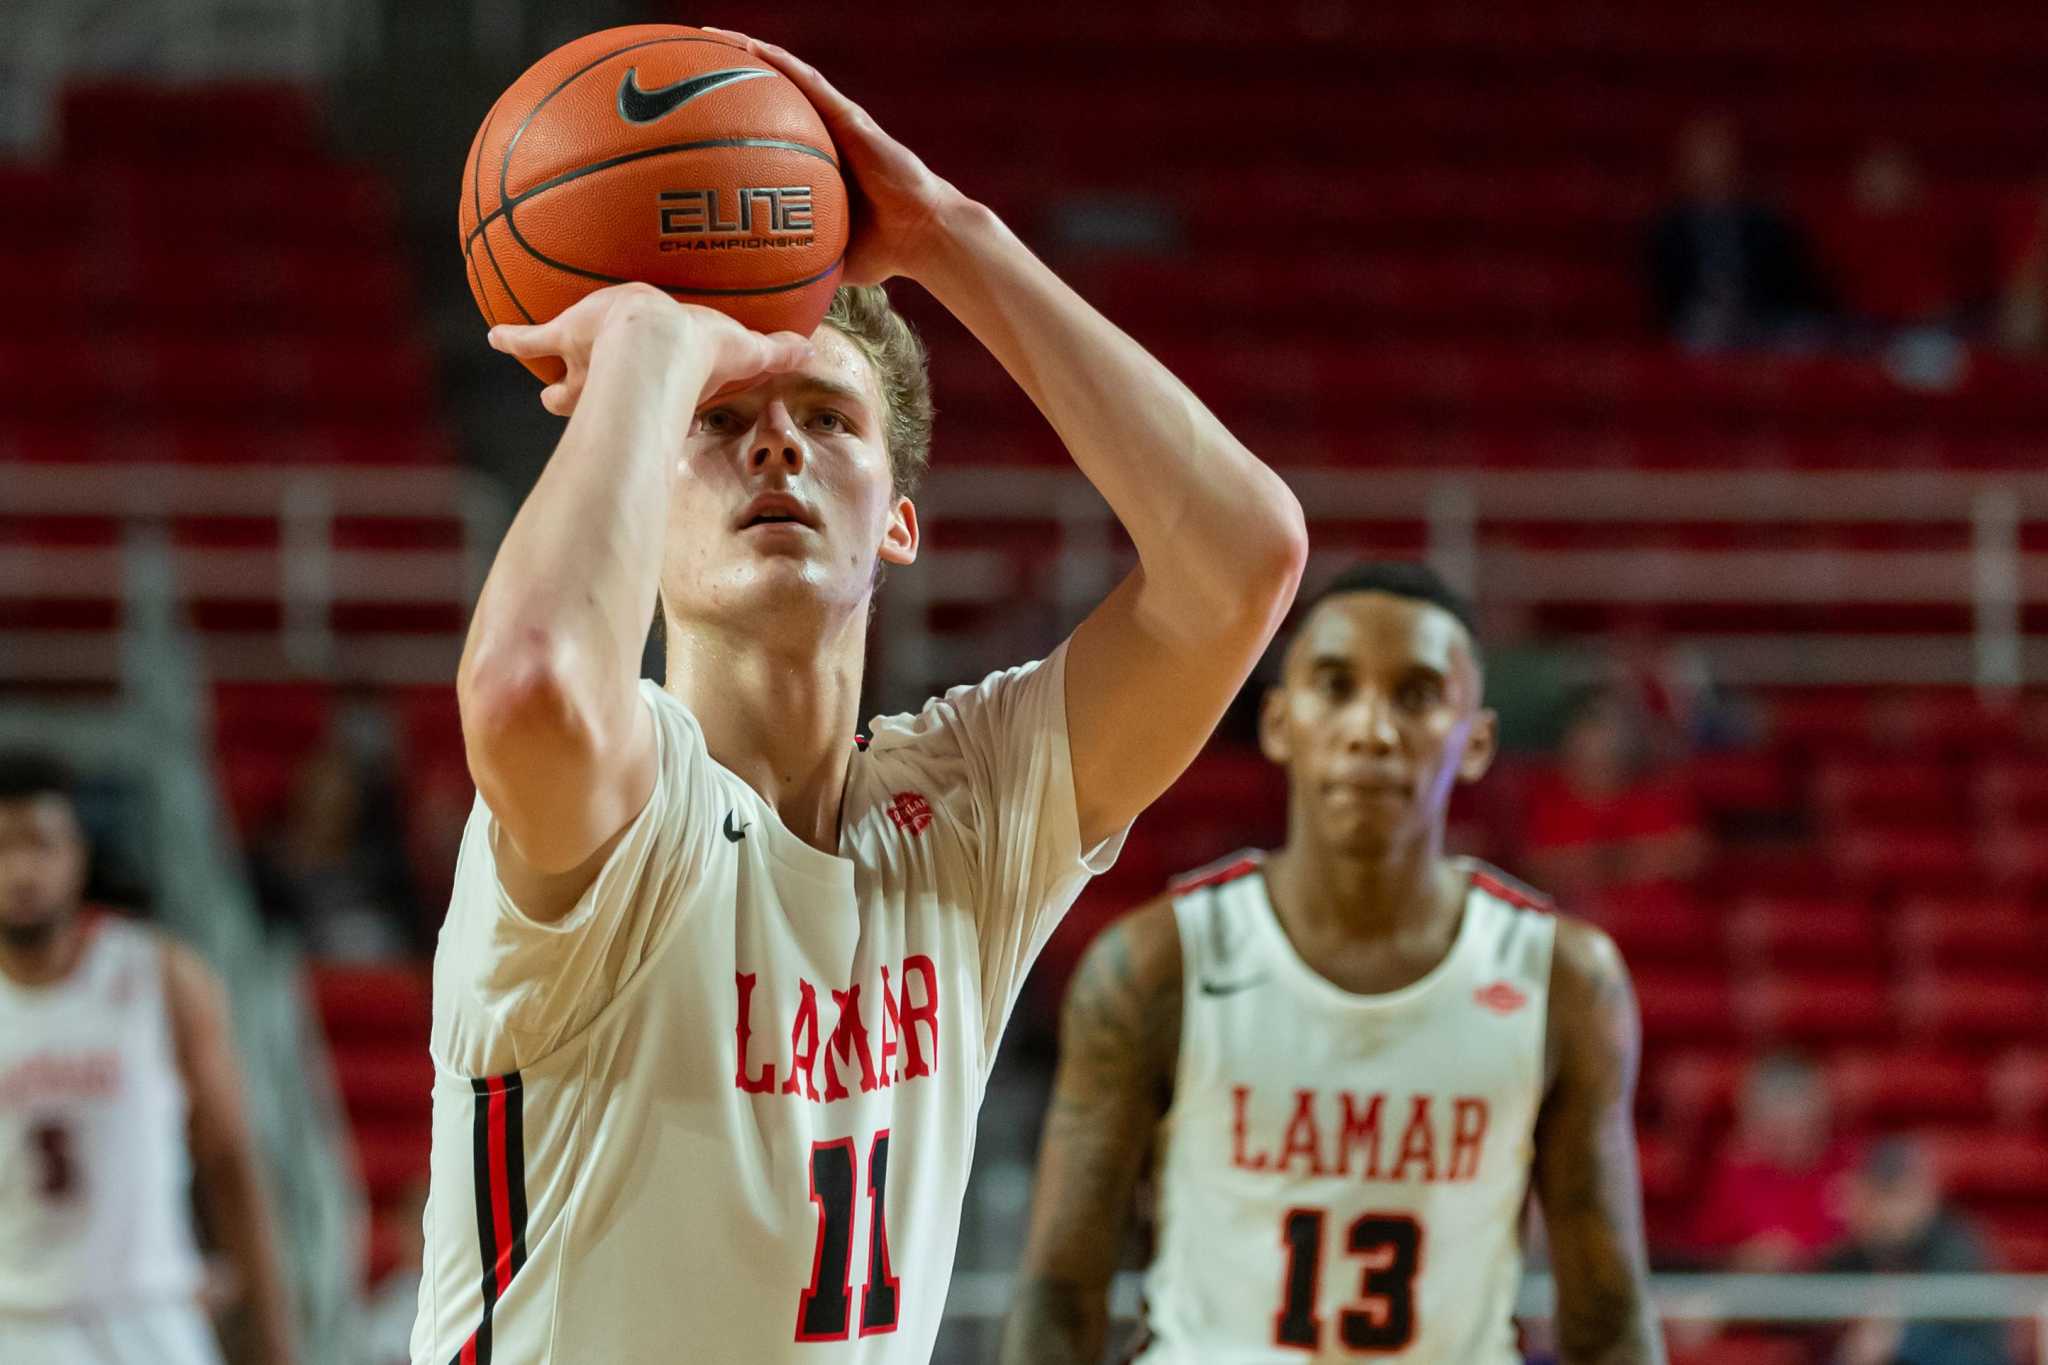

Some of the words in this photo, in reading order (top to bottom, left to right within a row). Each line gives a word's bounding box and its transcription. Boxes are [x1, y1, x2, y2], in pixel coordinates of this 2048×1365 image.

[657, 186, 815, 234] ELITE
[660, 236, 815, 251] CHAMPIONSHIP
[735, 955, 938, 1104] LAMAR
[1230, 1084, 1490, 1185] LAMAR
[795, 1128, 901, 1343] 11
[1273, 1206, 1426, 1355] 13
